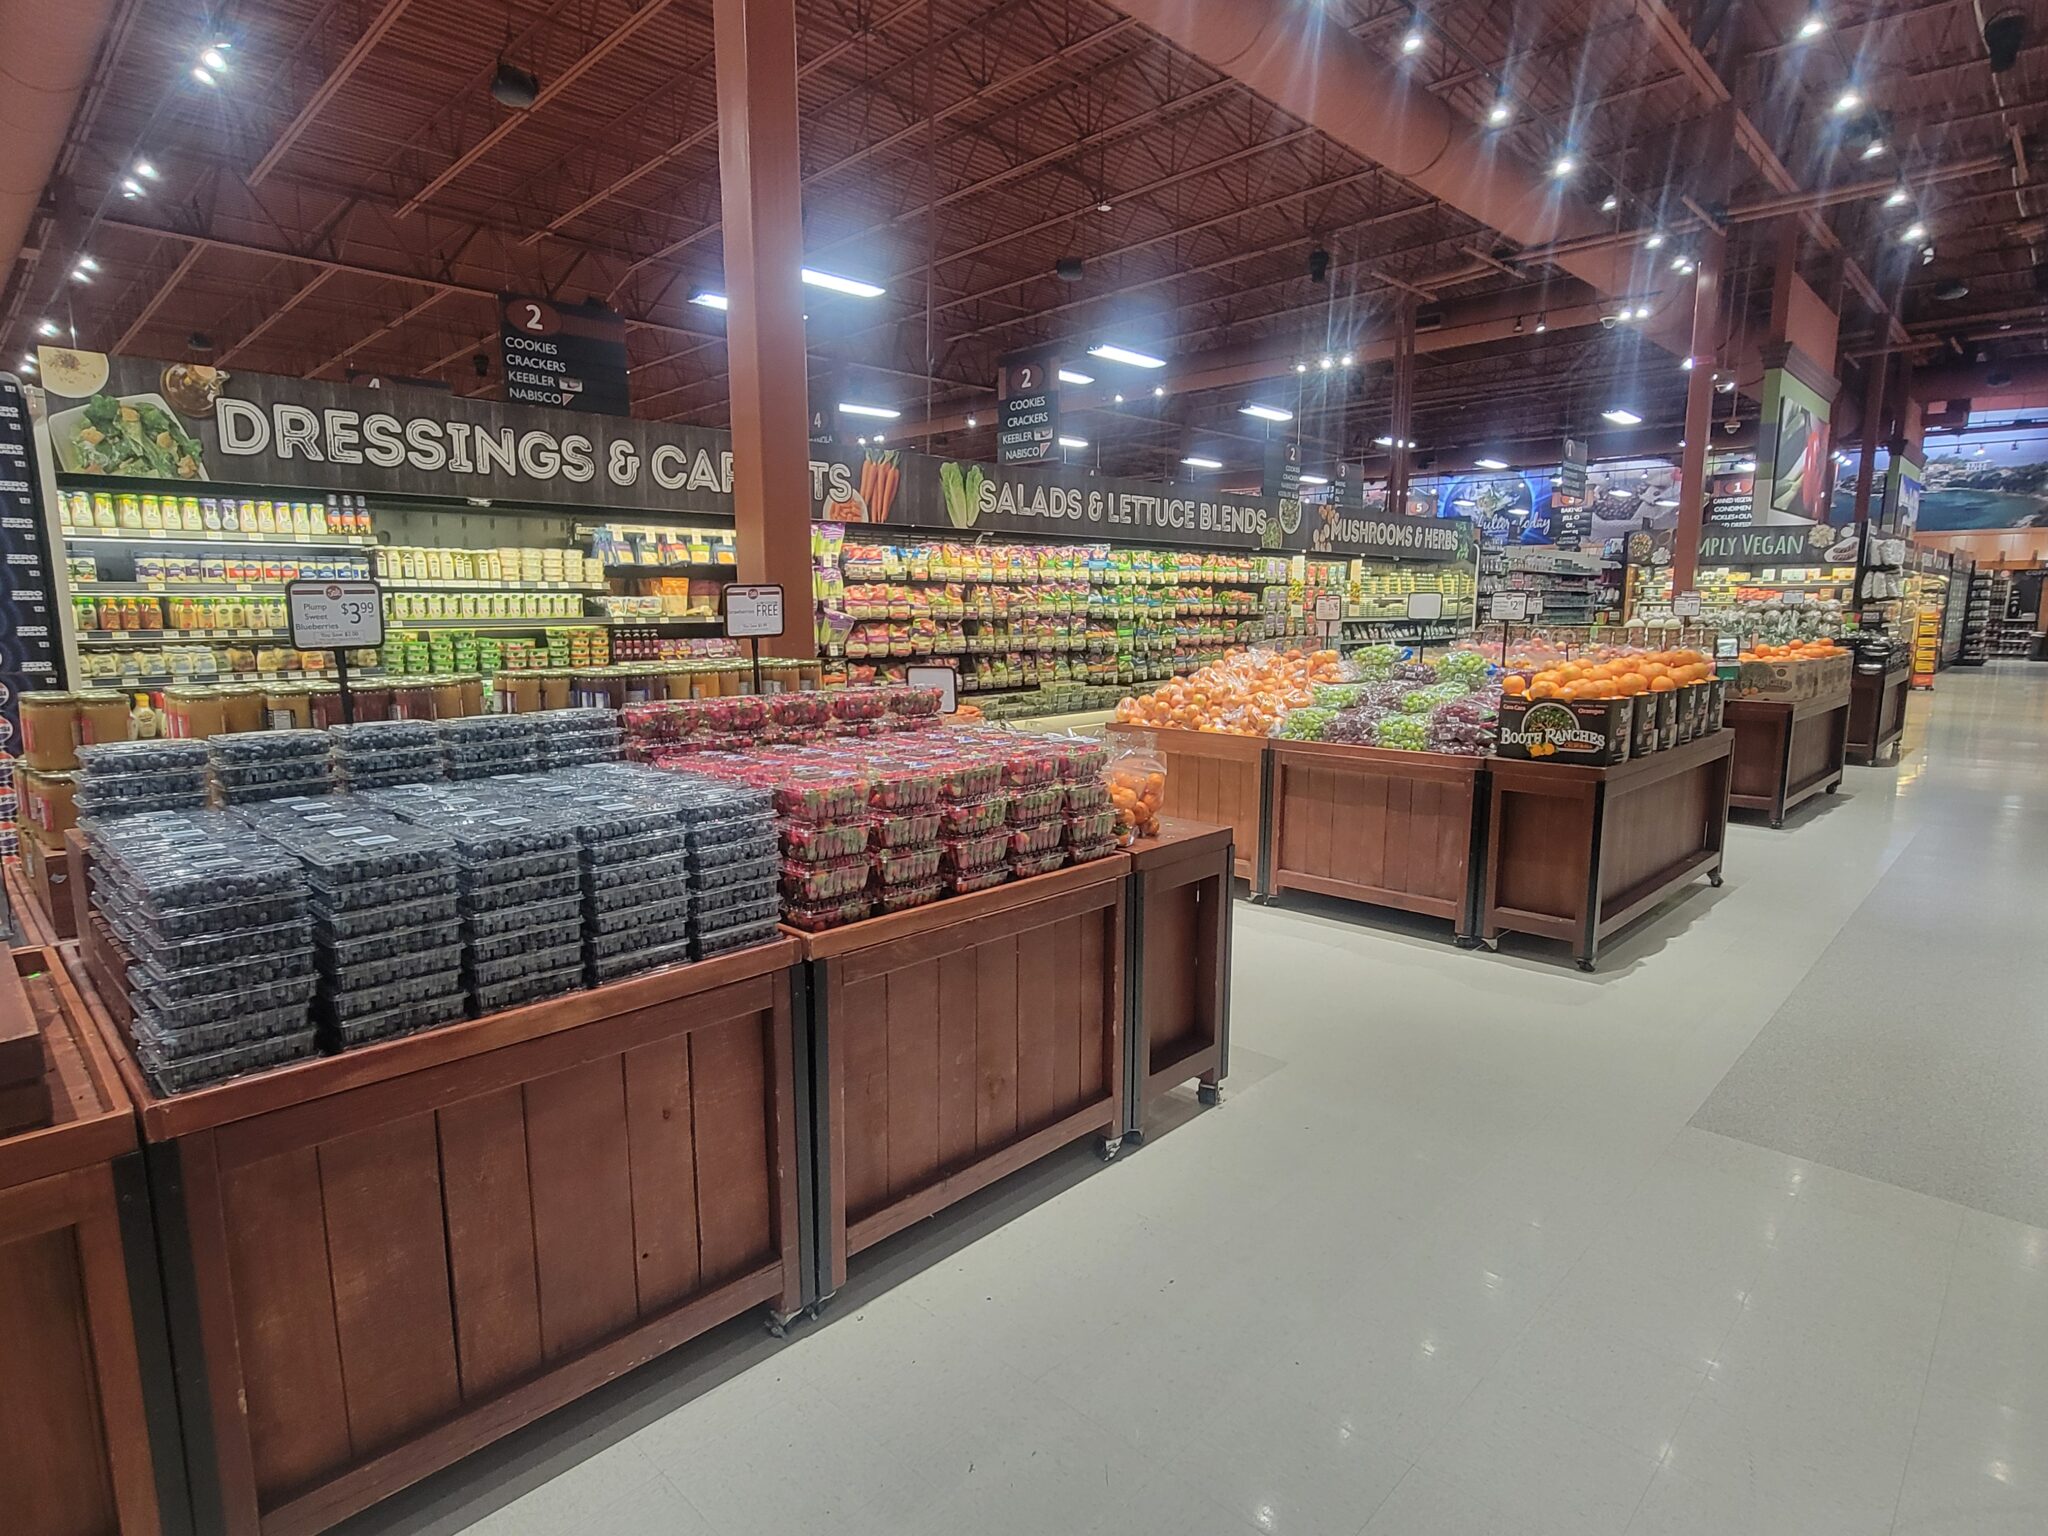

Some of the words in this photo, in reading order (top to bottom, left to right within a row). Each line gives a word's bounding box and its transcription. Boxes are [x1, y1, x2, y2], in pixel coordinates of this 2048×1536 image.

[526, 304, 543, 330] 2
[505, 337, 558, 354] COOKIES
[506, 354, 566, 372] CRACKERS
[508, 371, 556, 387] KEEBLER
[1021, 368, 1032, 388] 2
[509, 388, 562, 404] NABISCO
[1010, 396, 1046, 411] COOKIES
[814, 412, 821, 428] 4
[1008, 412, 1048, 428] CRACKERS
[216, 397, 595, 482] DRESSINGS
[607, 439, 639, 486] &
[1002, 432, 1032, 444] KEEBLER
[1005, 447, 1040, 460] NABISCO
[1290, 448, 1296, 460] 2
[1341, 466, 1346, 478] 3
[1734, 482, 1742, 492] 1
[979, 479, 1082, 520] SALADS
[1088, 491, 1104, 522] &
[1108, 493, 1195, 529] LETTUCE
[1200, 502, 1266, 535] BLENDS
[1416, 503, 1422, 512] 5
[1331, 518, 1412, 547] MUSHROOMS
[1414, 527, 1422, 548] &
[1425, 528, 1458, 550] HERBS
[1742, 534, 1804, 556] VEGAN
[304, 604, 326, 612] Plump
[756, 604, 778, 616] FREE
[1500, 727, 1542, 746] BOOTH
[1544, 728, 1605, 748] RANCHES
